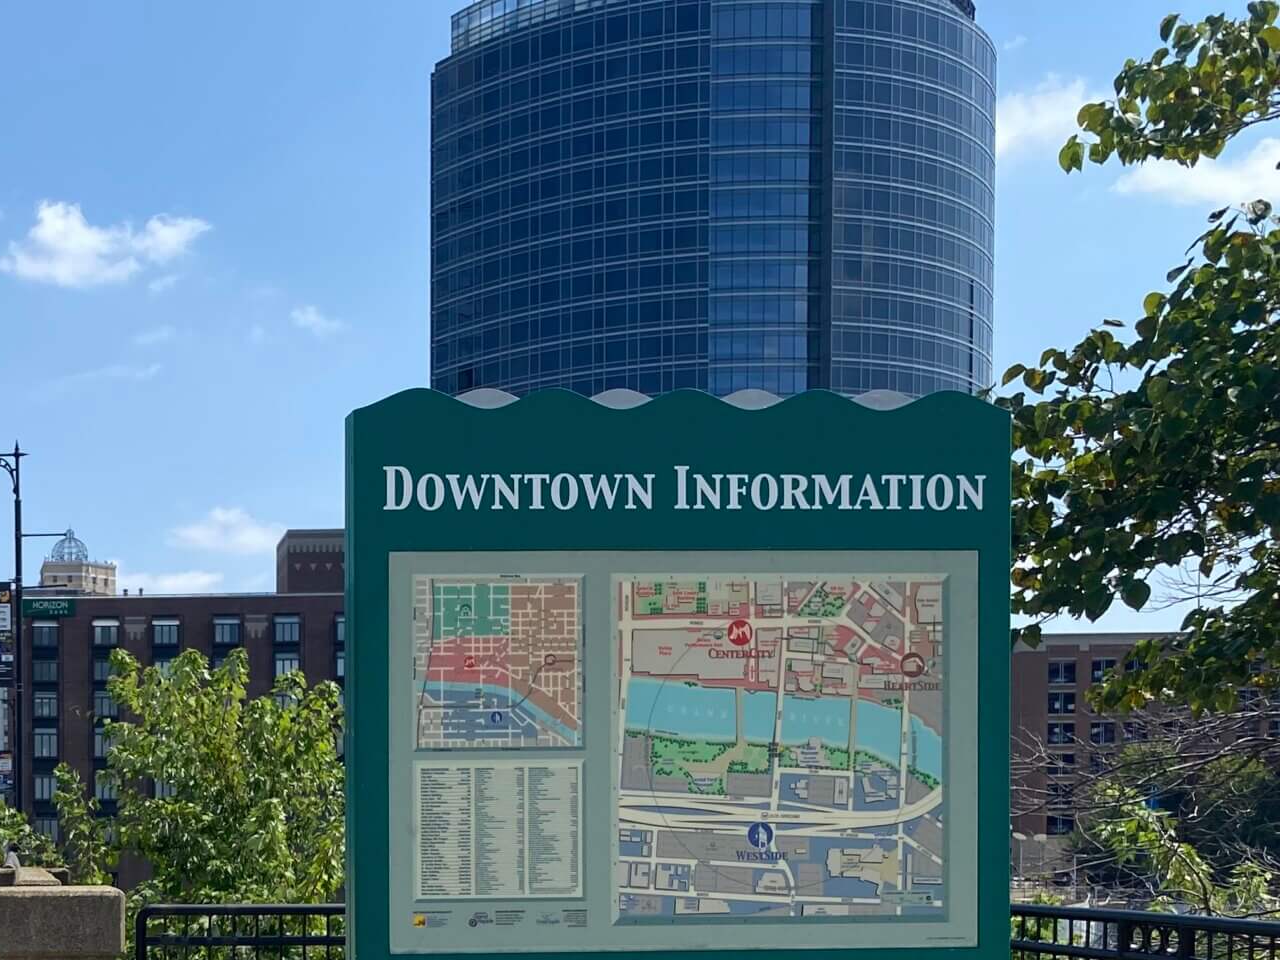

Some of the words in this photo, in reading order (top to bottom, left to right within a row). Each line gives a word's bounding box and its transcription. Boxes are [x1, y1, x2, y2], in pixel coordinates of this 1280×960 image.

[383, 466, 655, 511] DOWNTOWN
[673, 465, 986, 511] INFORMATION
[32, 601, 69, 609] HORIZON
